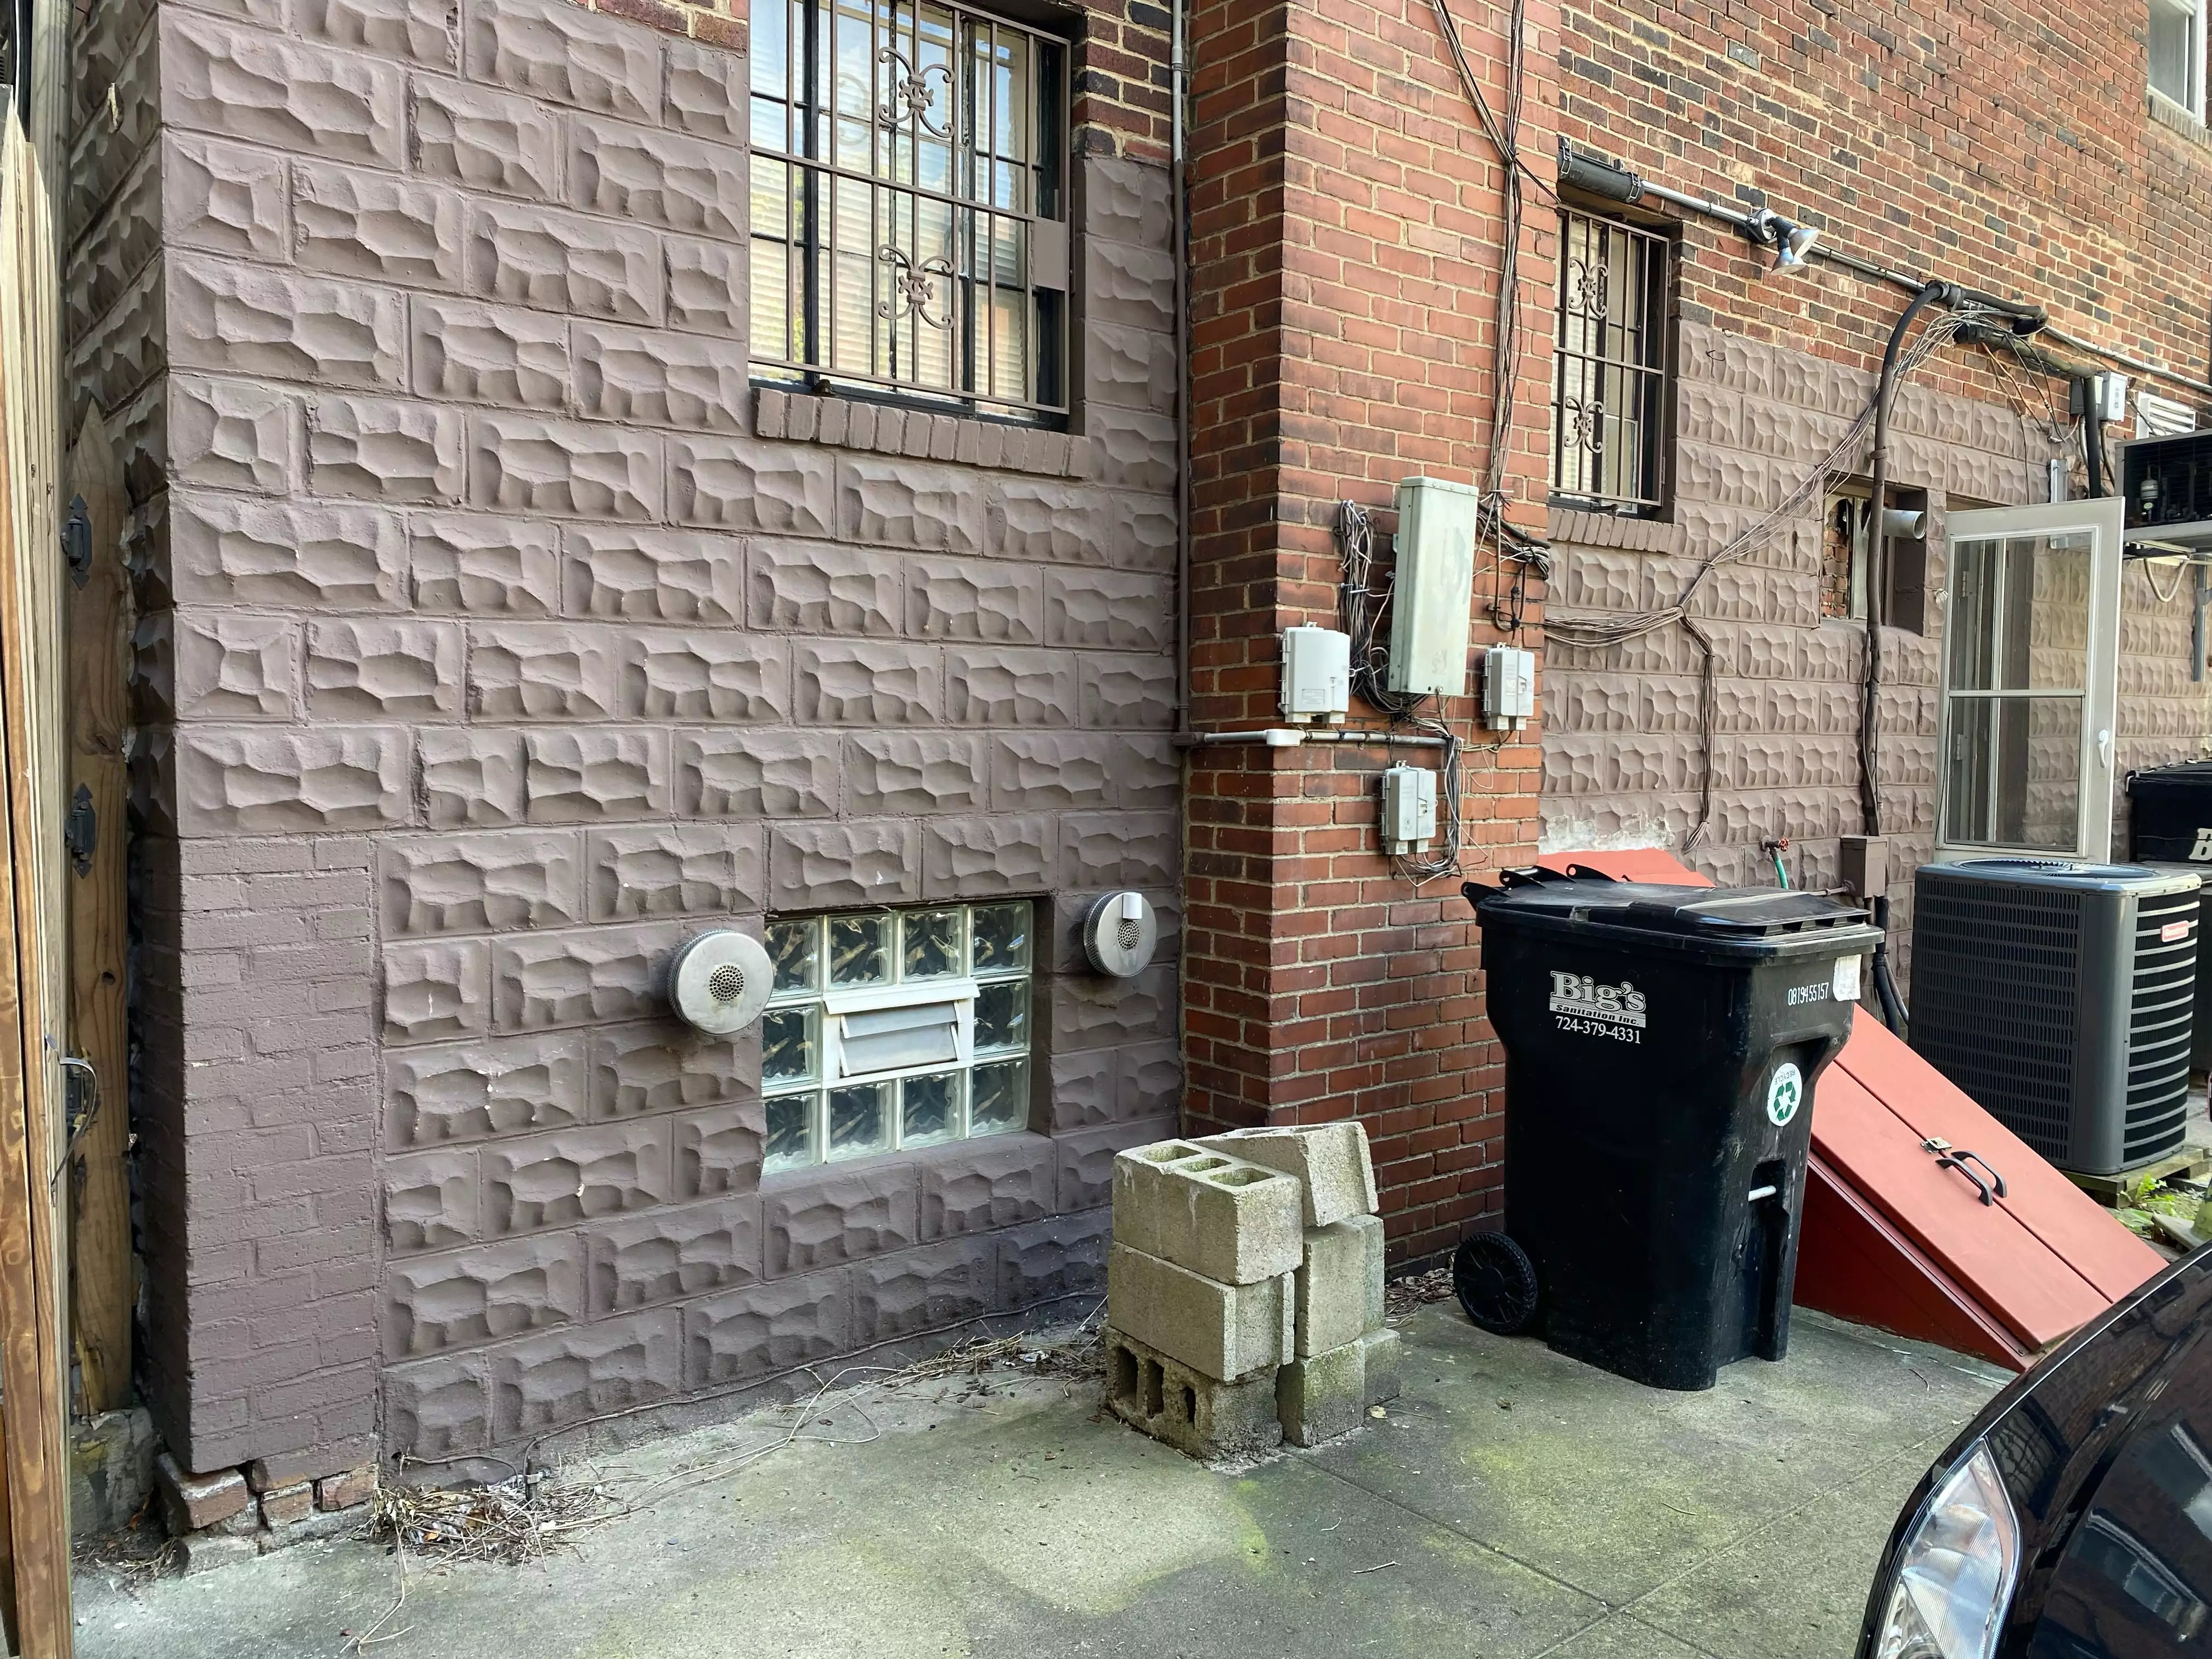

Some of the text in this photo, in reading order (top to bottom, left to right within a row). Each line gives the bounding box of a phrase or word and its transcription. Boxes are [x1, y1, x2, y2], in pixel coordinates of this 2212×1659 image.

[1550, 970, 1646, 1012] Big's
[1788, 982, 1829, 1006] 0819455157
[1555, 1015, 1641, 1044] 724-379-4331
[1619, 1015, 1639, 1025] Inc.
[1774, 1069, 1796, 1085] RECYCLE
